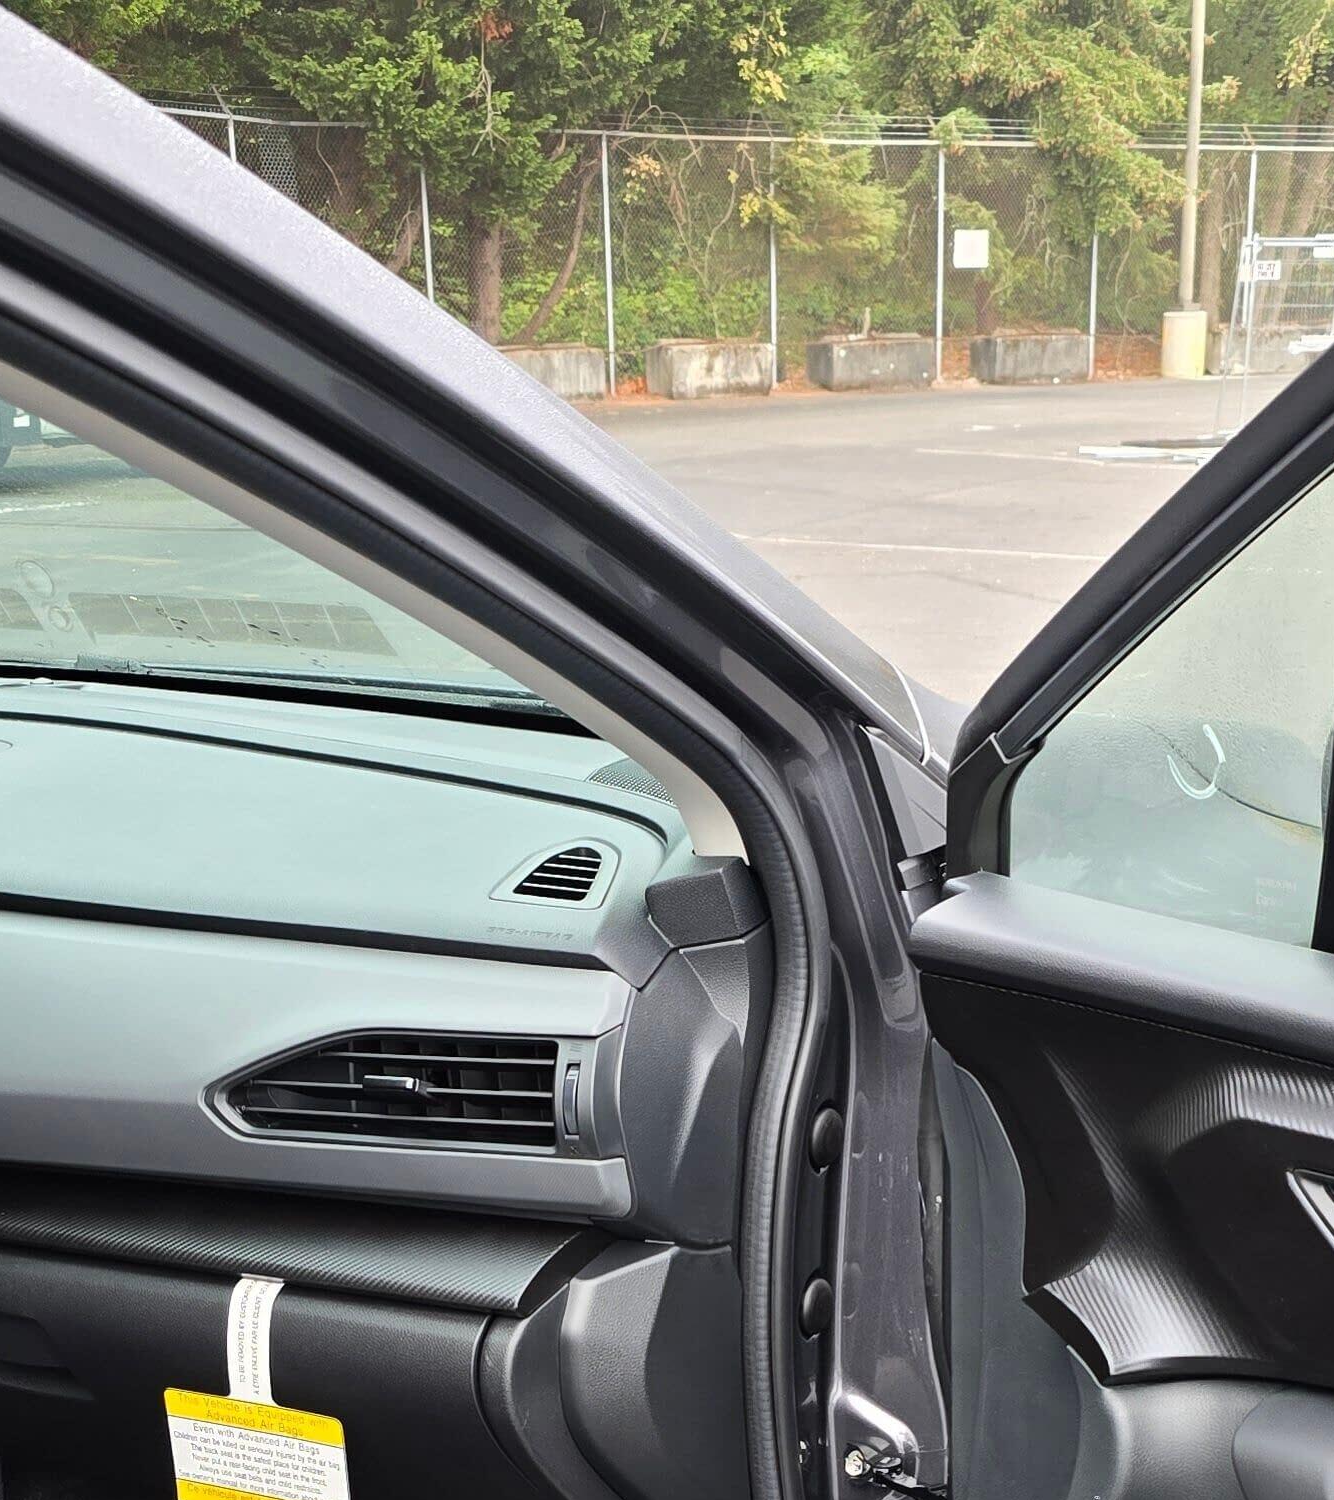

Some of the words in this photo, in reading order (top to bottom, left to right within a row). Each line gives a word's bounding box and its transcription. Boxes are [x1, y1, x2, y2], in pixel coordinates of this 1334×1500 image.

[203, 1397, 239, 1412] Vehicle
[244, 1406, 252, 1414] is
[257, 1407, 304, 1424] Equipped
[206, 1408, 255, 1427] Advanced
[259, 1419, 273, 1430] Air
[278, 1423, 303, 1437] Bags
[192, 1422, 214, 1434] Even
[218, 1428, 234, 1438] with
[238, 1431, 279, 1447] Advanced
[283, 1440, 295, 1449] Air
[298, 1442, 319, 1456] Bags
